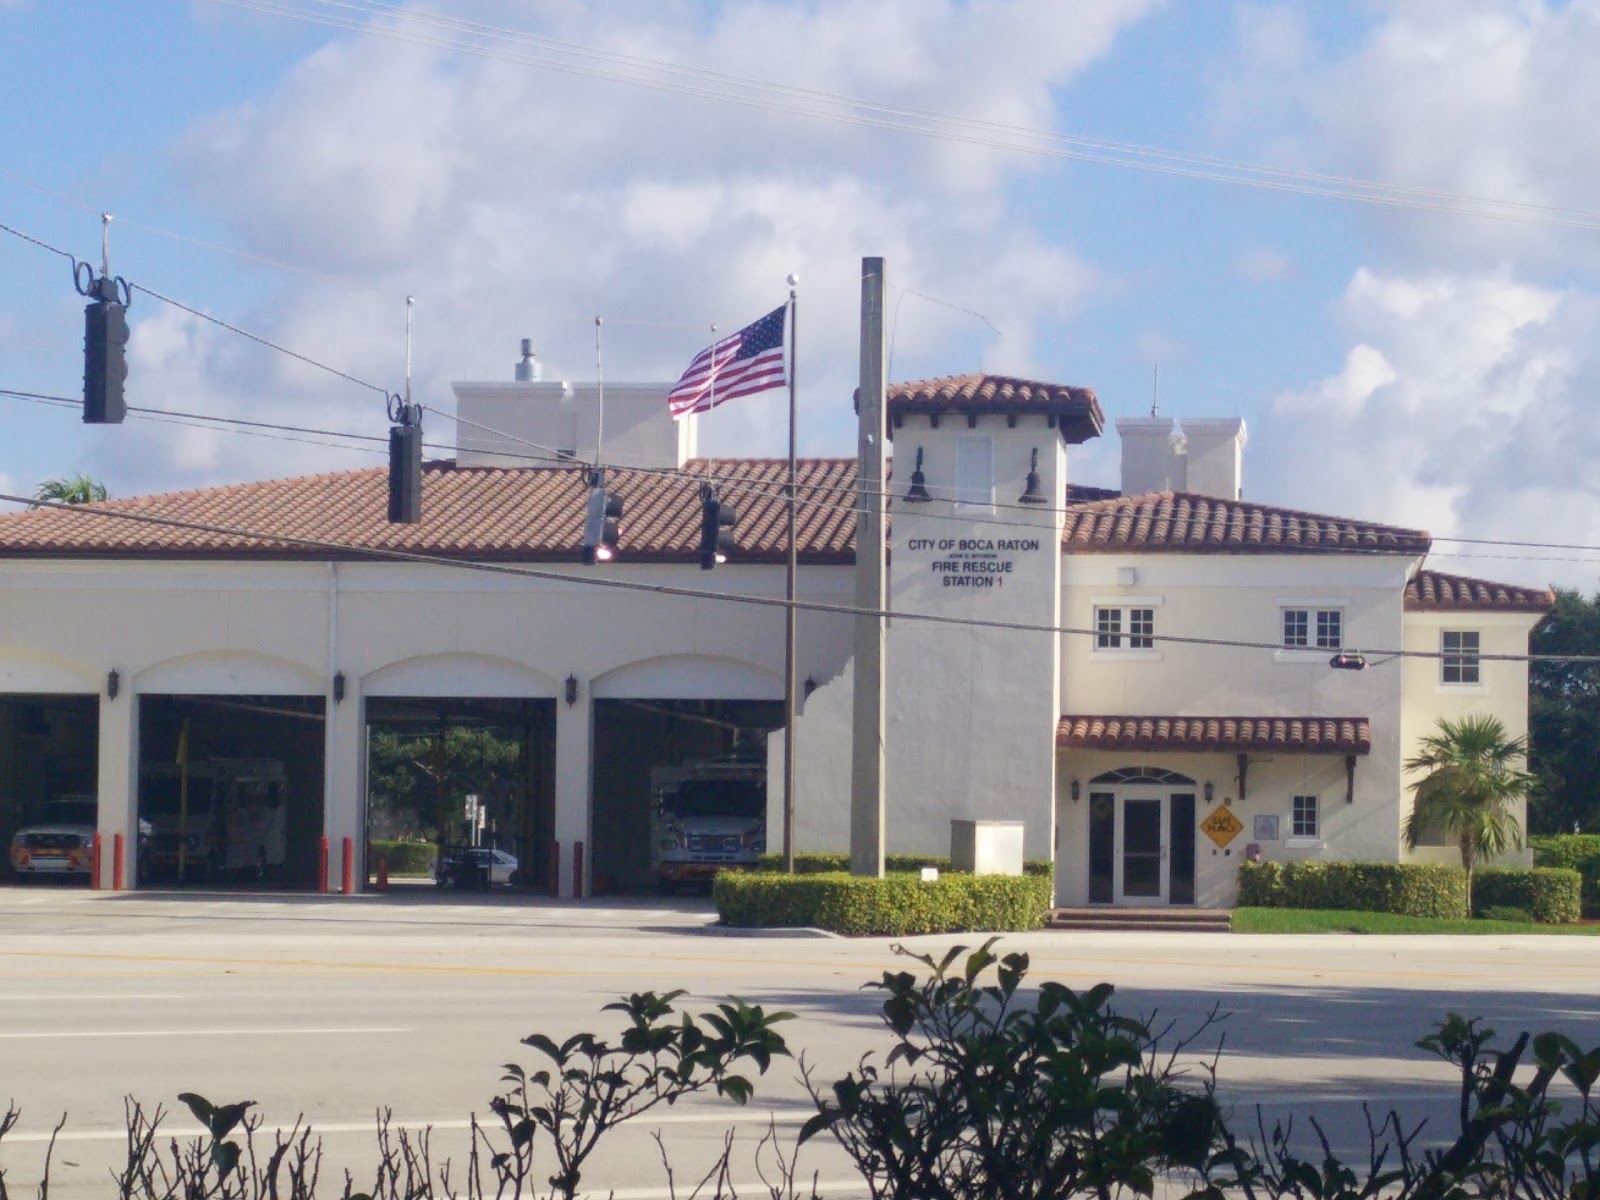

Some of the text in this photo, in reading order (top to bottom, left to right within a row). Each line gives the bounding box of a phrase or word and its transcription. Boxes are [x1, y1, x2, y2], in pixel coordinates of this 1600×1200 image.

[908, 539, 1039, 551] CITY OF BOCA RATON
[932, 562, 1013, 573] FIRE RESCUE
[943, 577, 1003, 588] STATION 1
